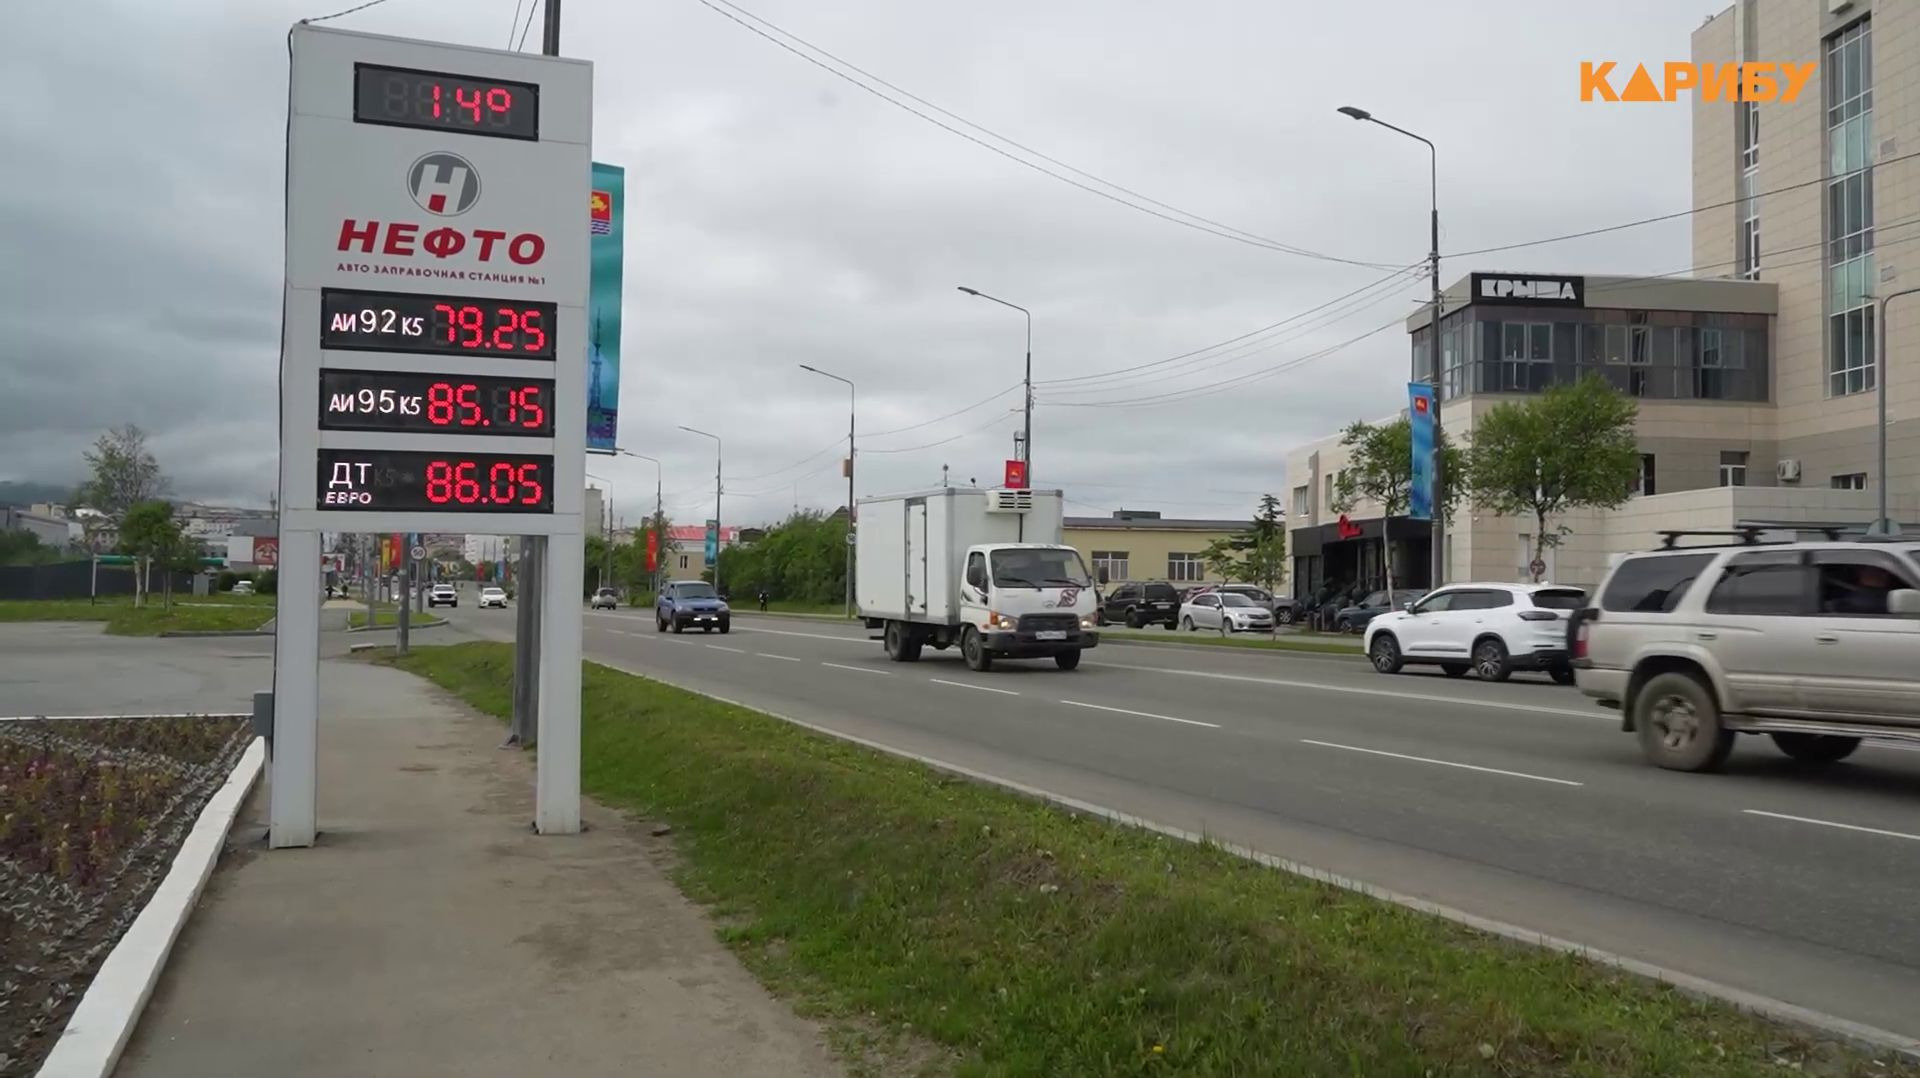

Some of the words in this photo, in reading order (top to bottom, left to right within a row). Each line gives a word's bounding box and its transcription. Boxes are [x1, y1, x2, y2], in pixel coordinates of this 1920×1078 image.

[337, 219, 545, 265] НЕФТО
[337, 263, 370, 273] АВТО
[373, 265, 465, 280] ЗАПРАВОЧНАЯ
[468, 272, 525, 284] СТАНЦИЯ
[433, 304, 545, 351] 79.25
[427, 383, 544, 428] 85.15
[325, 491, 372, 504] ЕВРО
[328, 462, 373, 489] ДТ
[425, 462, 542, 505] 86.05
